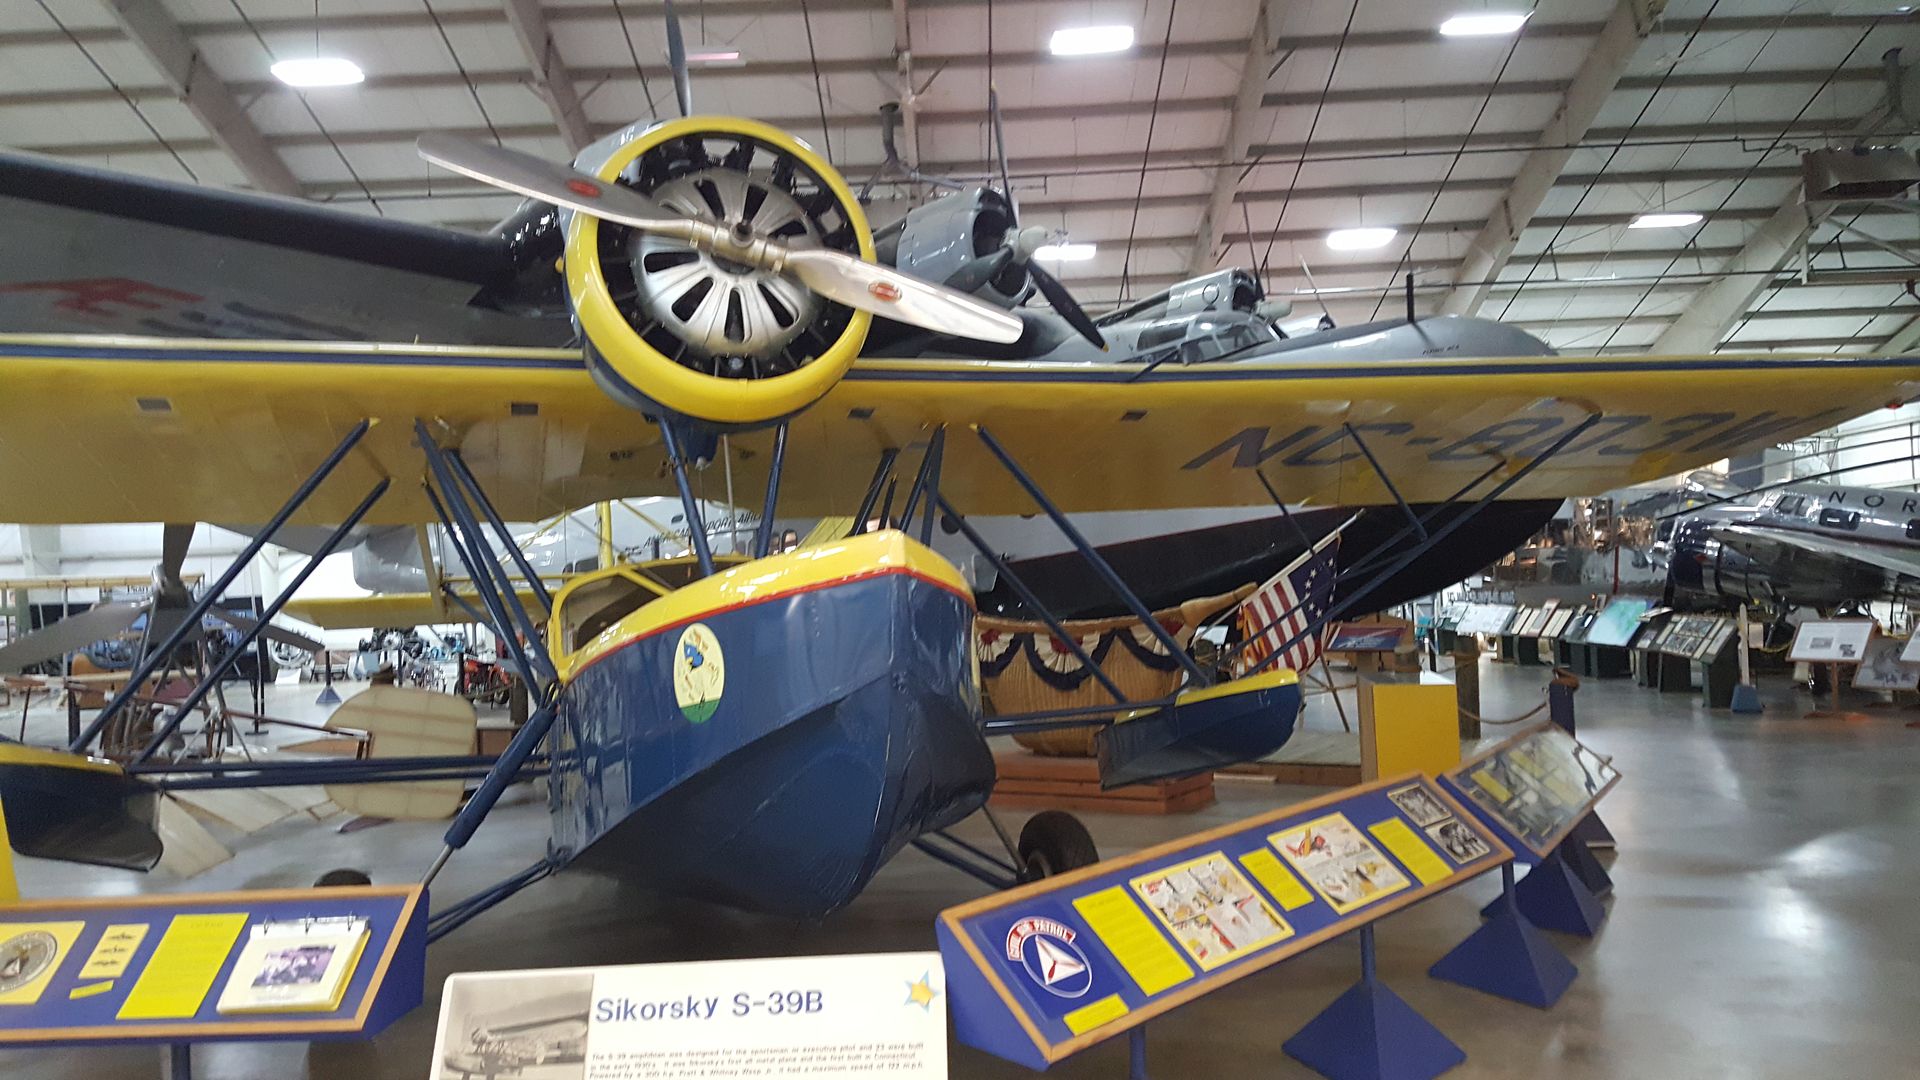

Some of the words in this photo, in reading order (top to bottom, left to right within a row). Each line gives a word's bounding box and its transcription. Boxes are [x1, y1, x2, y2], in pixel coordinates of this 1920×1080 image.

[596, 995, 719, 1022] Sikorsky
[732, 990, 823, 1016] S-39B
[686, 1049, 719, 1059] designed
[722, 1048, 732, 1056] for
[736, 1047, 747, 1056] the
[750, 1047, 788, 1057] sportsman
[802, 1045, 836, 1053] executive
[840, 1044, 856, 1054] pilot
[859, 1043, 872, 1051] and
[888, 1043, 905, 1051] were
[590, 1070, 621, 1079] Powered
[787, 1065, 801, 1073] had
[812, 1064, 847, 1073] maximum
[850, 1063, 873, 1071] speed
[614, 1062, 630, 1072] early
[778, 1055, 797, 1064] plane
[800, 1054, 813, 1062] and
[816, 1053, 826, 1061] the
[830, 1053, 844, 1062] first
